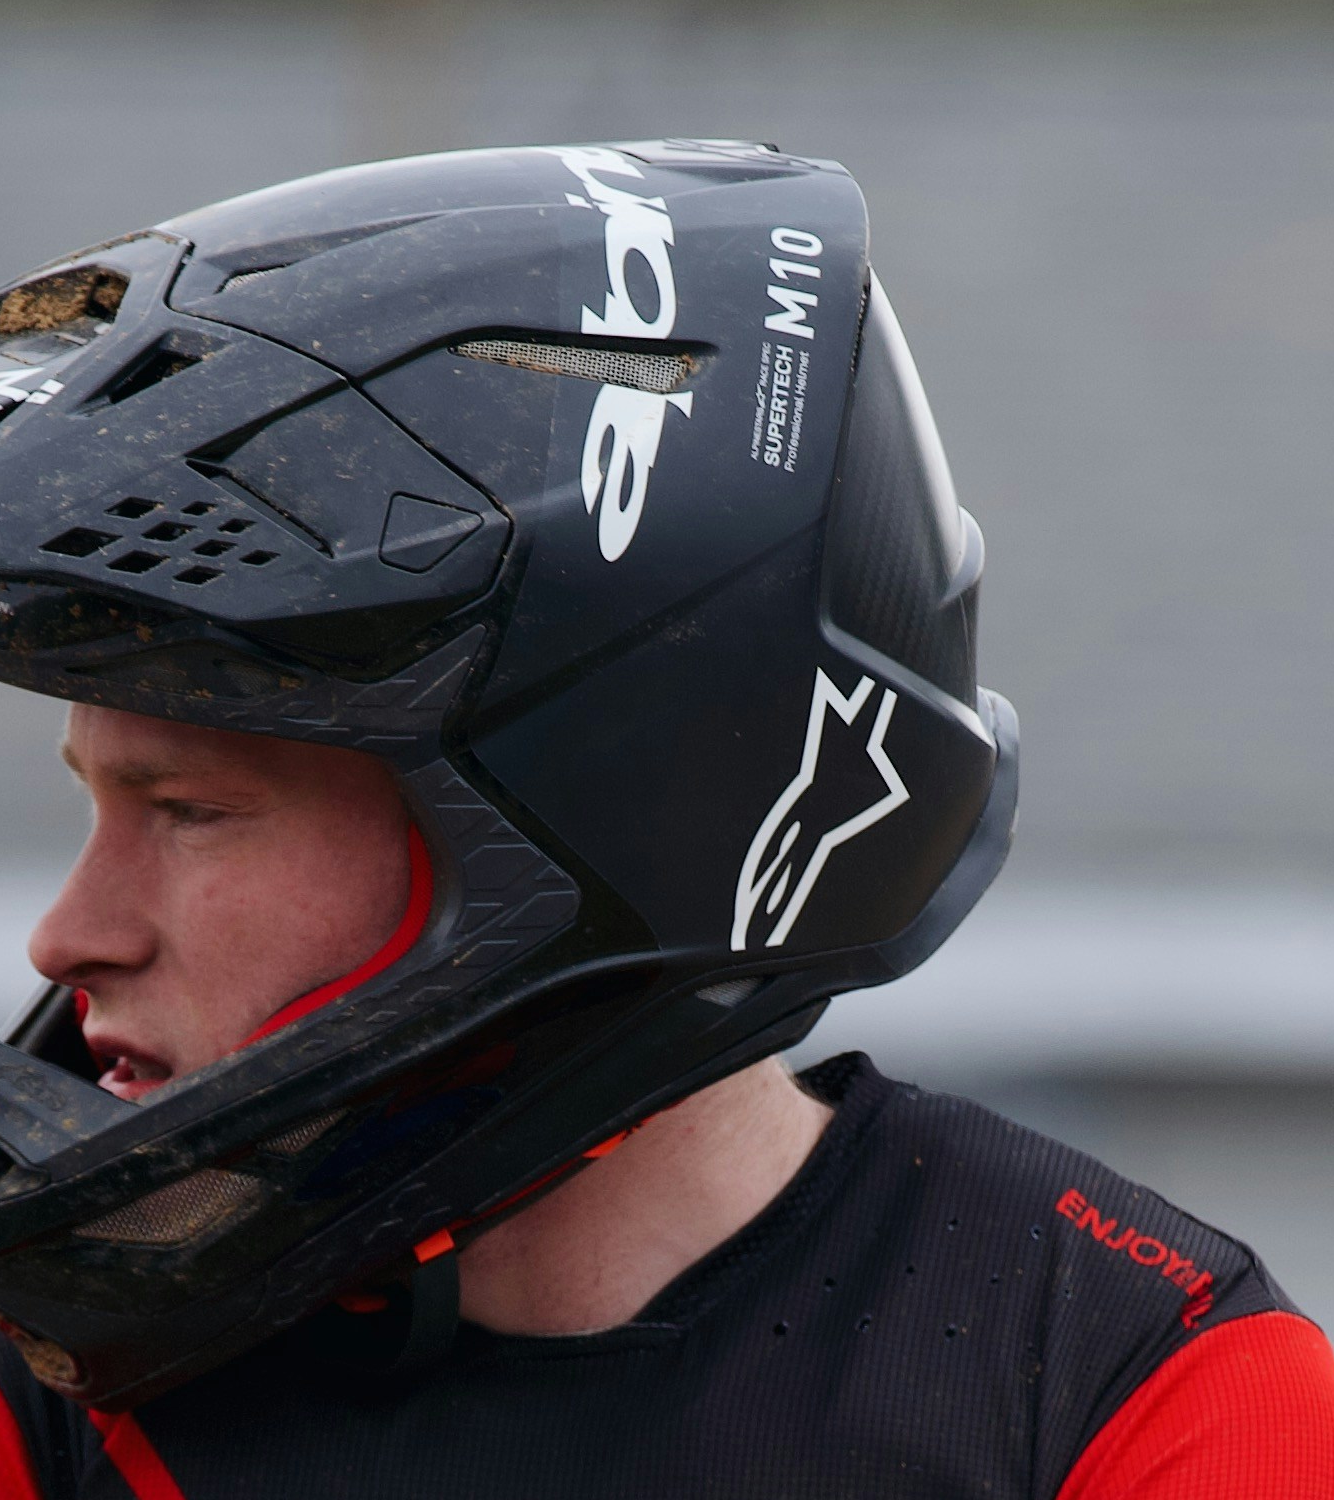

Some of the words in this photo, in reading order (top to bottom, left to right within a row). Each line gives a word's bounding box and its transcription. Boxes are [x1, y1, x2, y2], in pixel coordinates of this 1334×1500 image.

[764, 226, 824, 340] M10
[764, 344, 795, 468] SUPERTECH
[793, 350, 811, 397] Helmet
[784, 396, 806, 473] Professional
[1055, 1187, 1194, 1278] ENJOY
